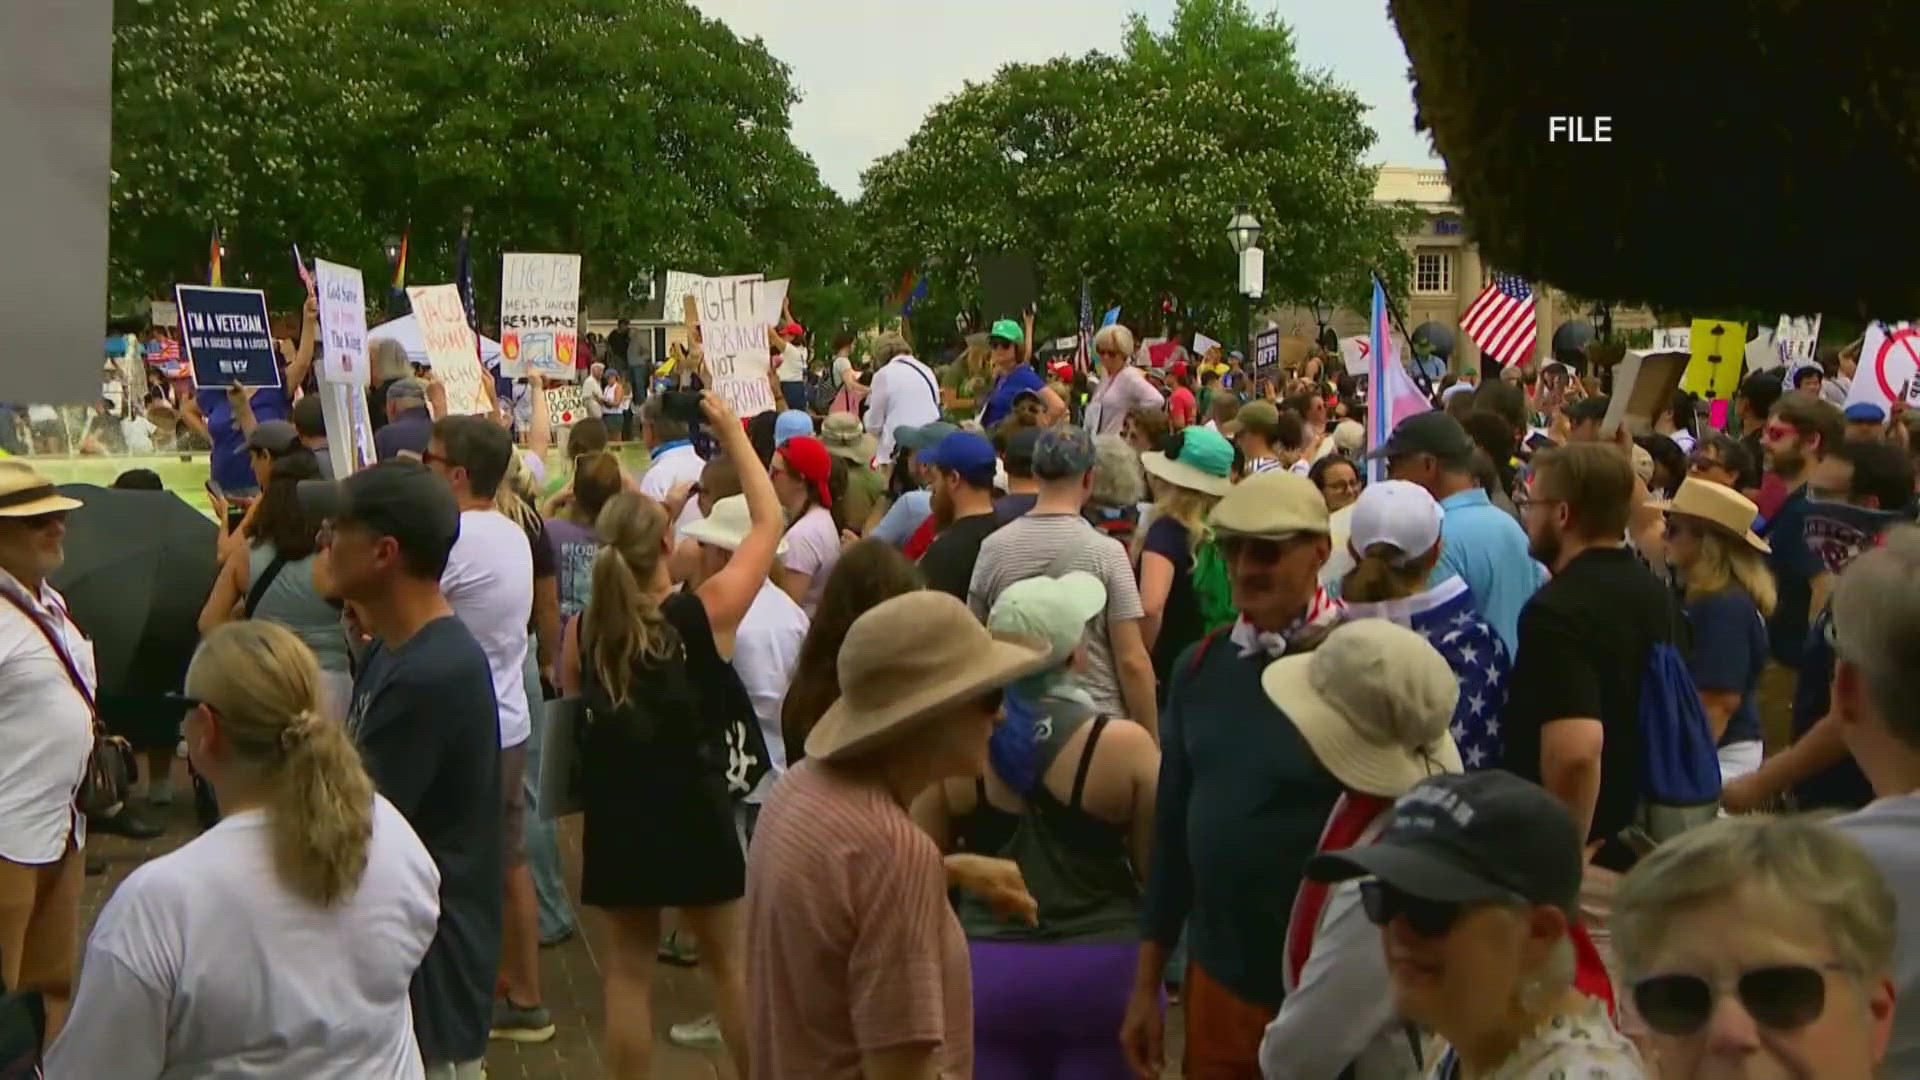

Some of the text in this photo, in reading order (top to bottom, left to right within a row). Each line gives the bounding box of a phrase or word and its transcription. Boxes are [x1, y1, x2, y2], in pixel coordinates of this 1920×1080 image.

[510, 256, 573, 294] ICE
[505, 299, 539, 311] MELTS
[187, 312, 205, 331] I'M
[206, 312, 215, 332] A
[215, 313, 266, 335] VETERAN,
[502, 315, 576, 329] RESISTANCE
[711, 355, 736, 376] NOT
